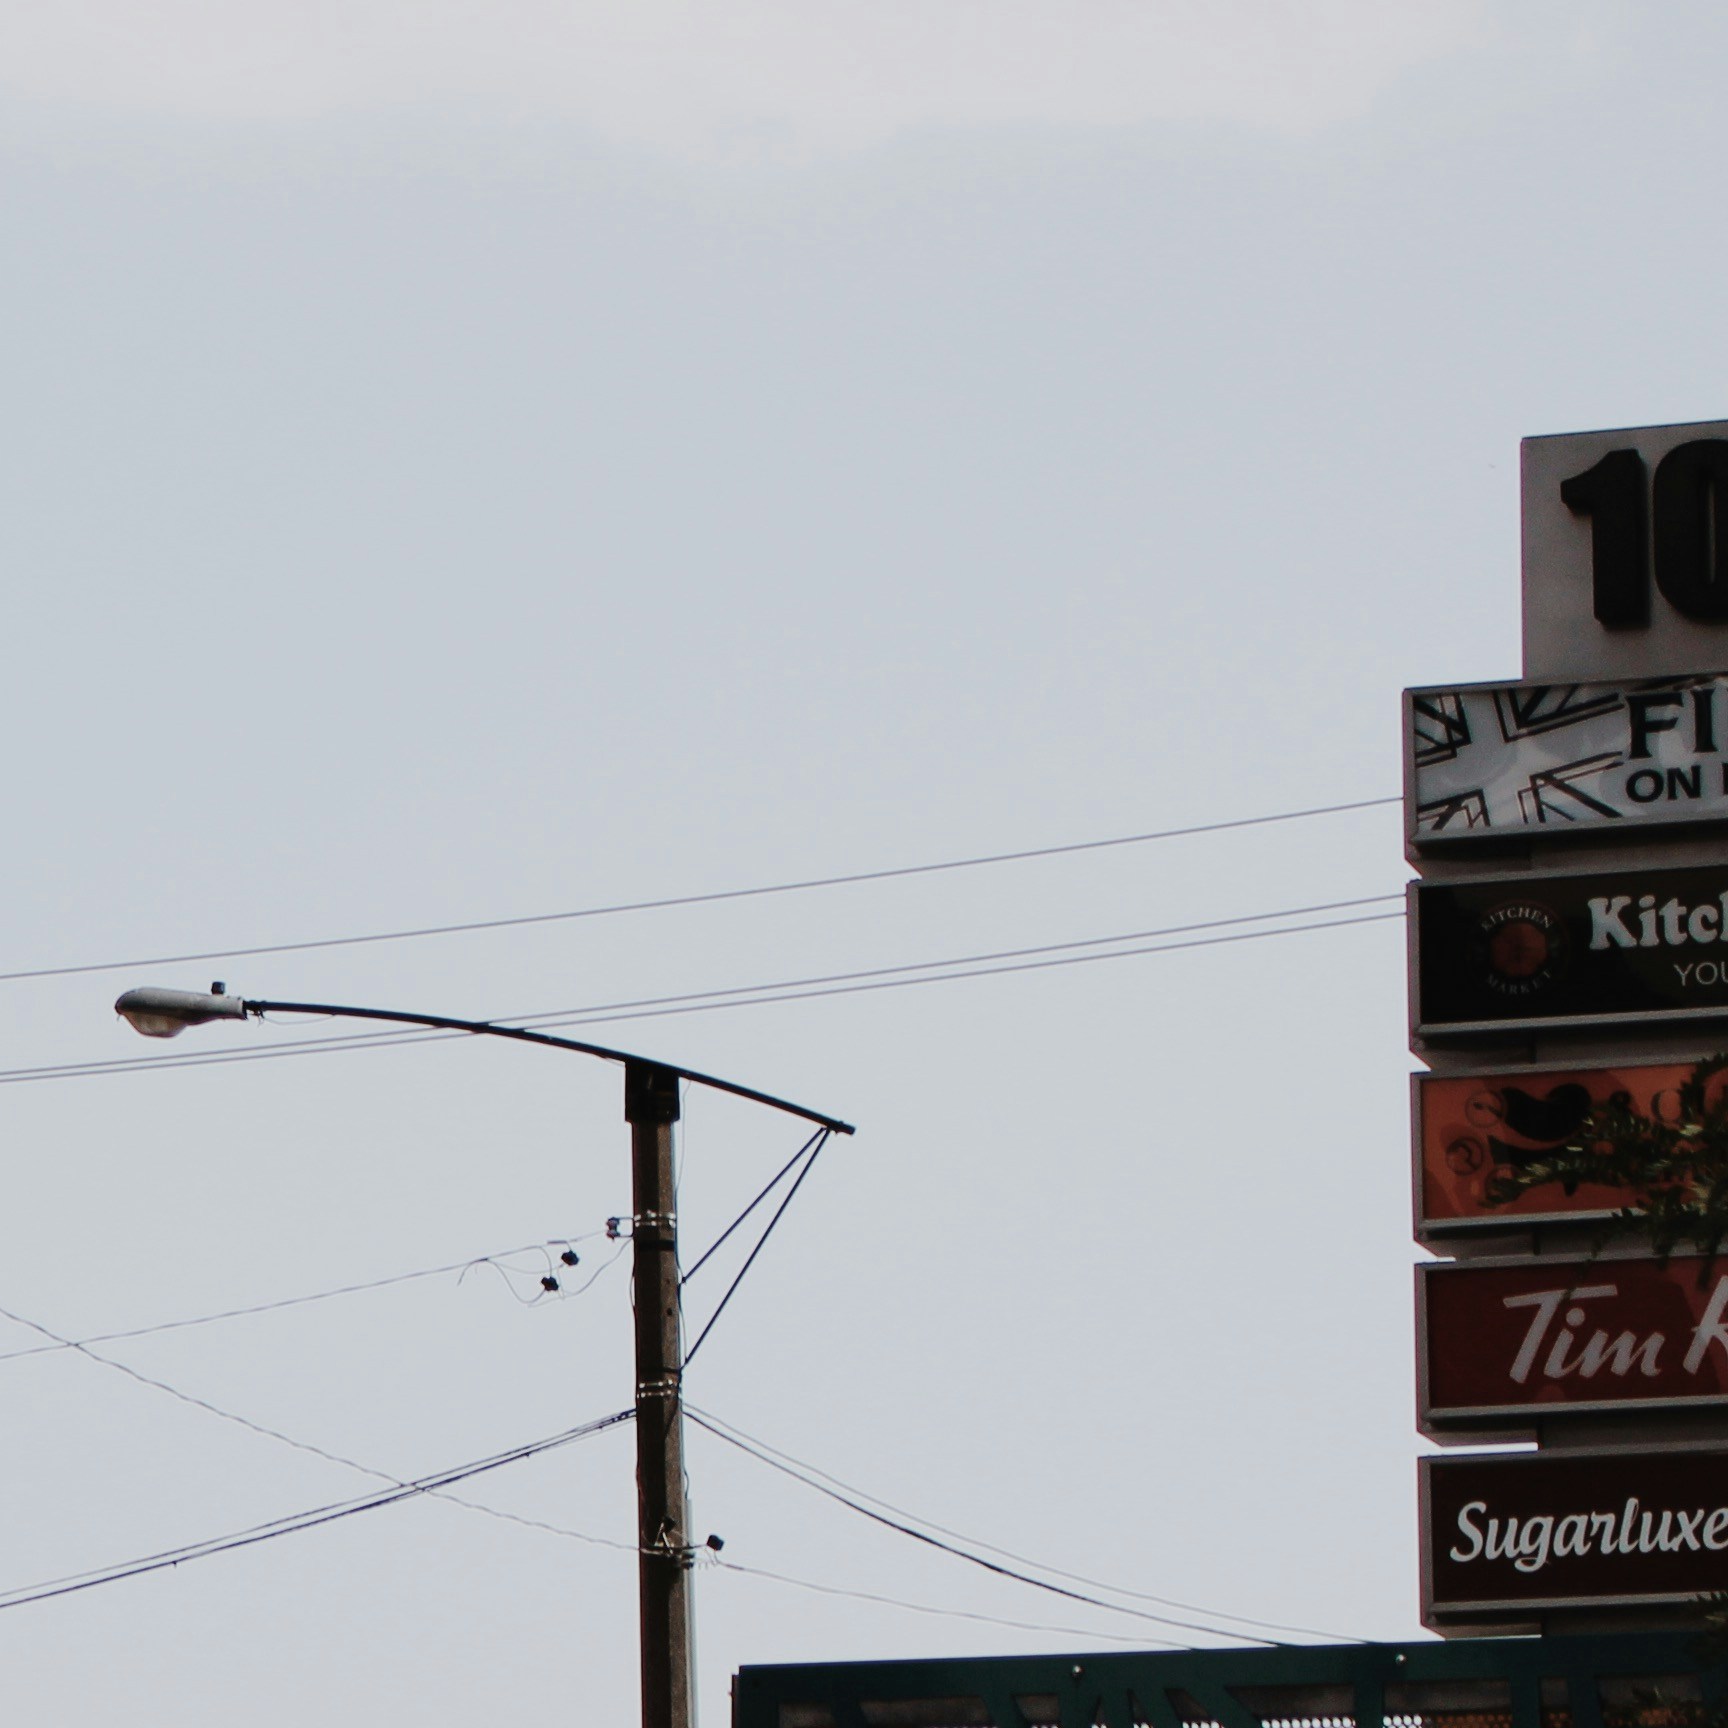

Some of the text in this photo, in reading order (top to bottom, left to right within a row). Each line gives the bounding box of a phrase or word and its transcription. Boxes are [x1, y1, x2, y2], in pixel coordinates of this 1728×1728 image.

[1625, 764, 1702, 804] ON
[1479, 904, 1552, 932] KITCHEN
[1502, 1283, 1666, 1384] Tim
[1449, 1497, 1728, 1573] Sugarluxe
